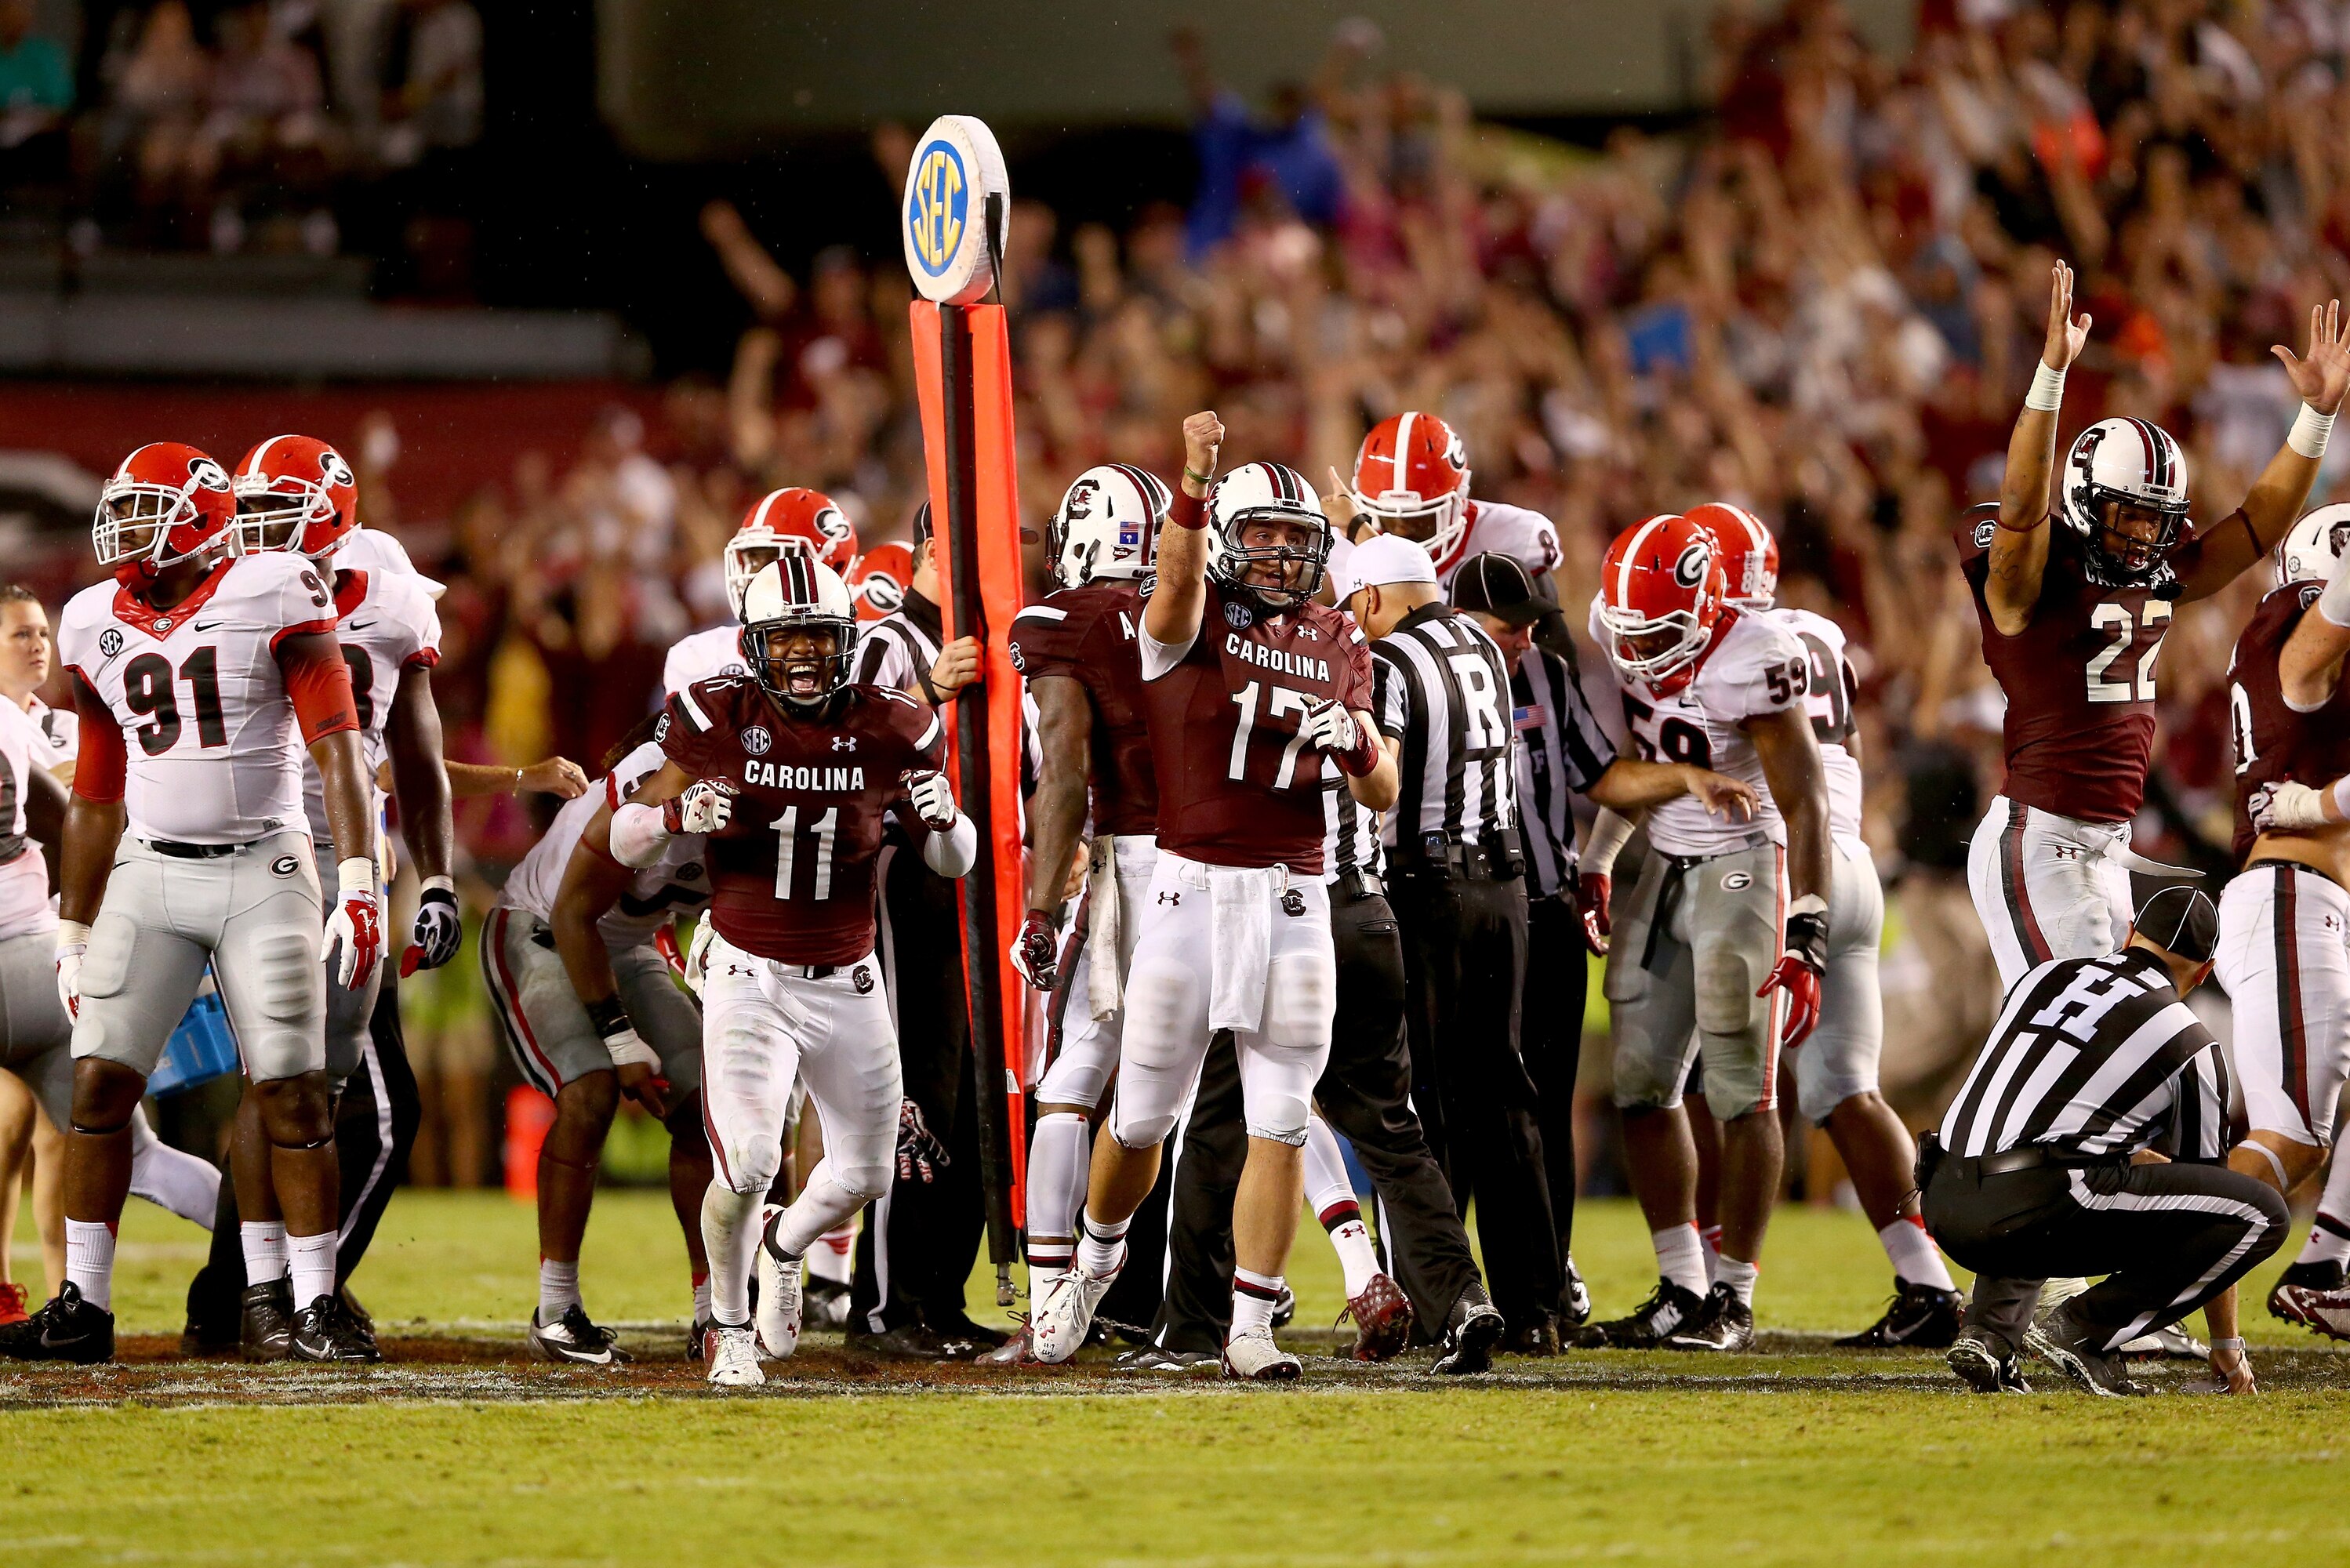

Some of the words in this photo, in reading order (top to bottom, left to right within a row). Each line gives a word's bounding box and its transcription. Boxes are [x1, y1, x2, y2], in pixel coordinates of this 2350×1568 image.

[912, 150, 962, 267] SEC
[300, 569, 336, 608] 9
[1226, 603, 1251, 628] SEC
[100, 630, 123, 657] SEC
[1226, 633, 1331, 683] CAROLINA
[2086, 599, 2173, 702] 22
[123, 645, 228, 757] 91
[1447, 652, 1506, 750] R
[1764, 656, 1807, 705] 59
[742, 727, 770, 754] SEC
[1228, 680, 1313, 789] 17
[1621, 688, 1713, 771] 59
[744, 759, 865, 791] CAROLINA
[272, 855, 300, 876] G
[769, 805, 837, 901] 11
[1723, 873, 1752, 891] G
[2029, 964, 2148, 1044] H
[1651, 1301, 1684, 1338] NIKE
